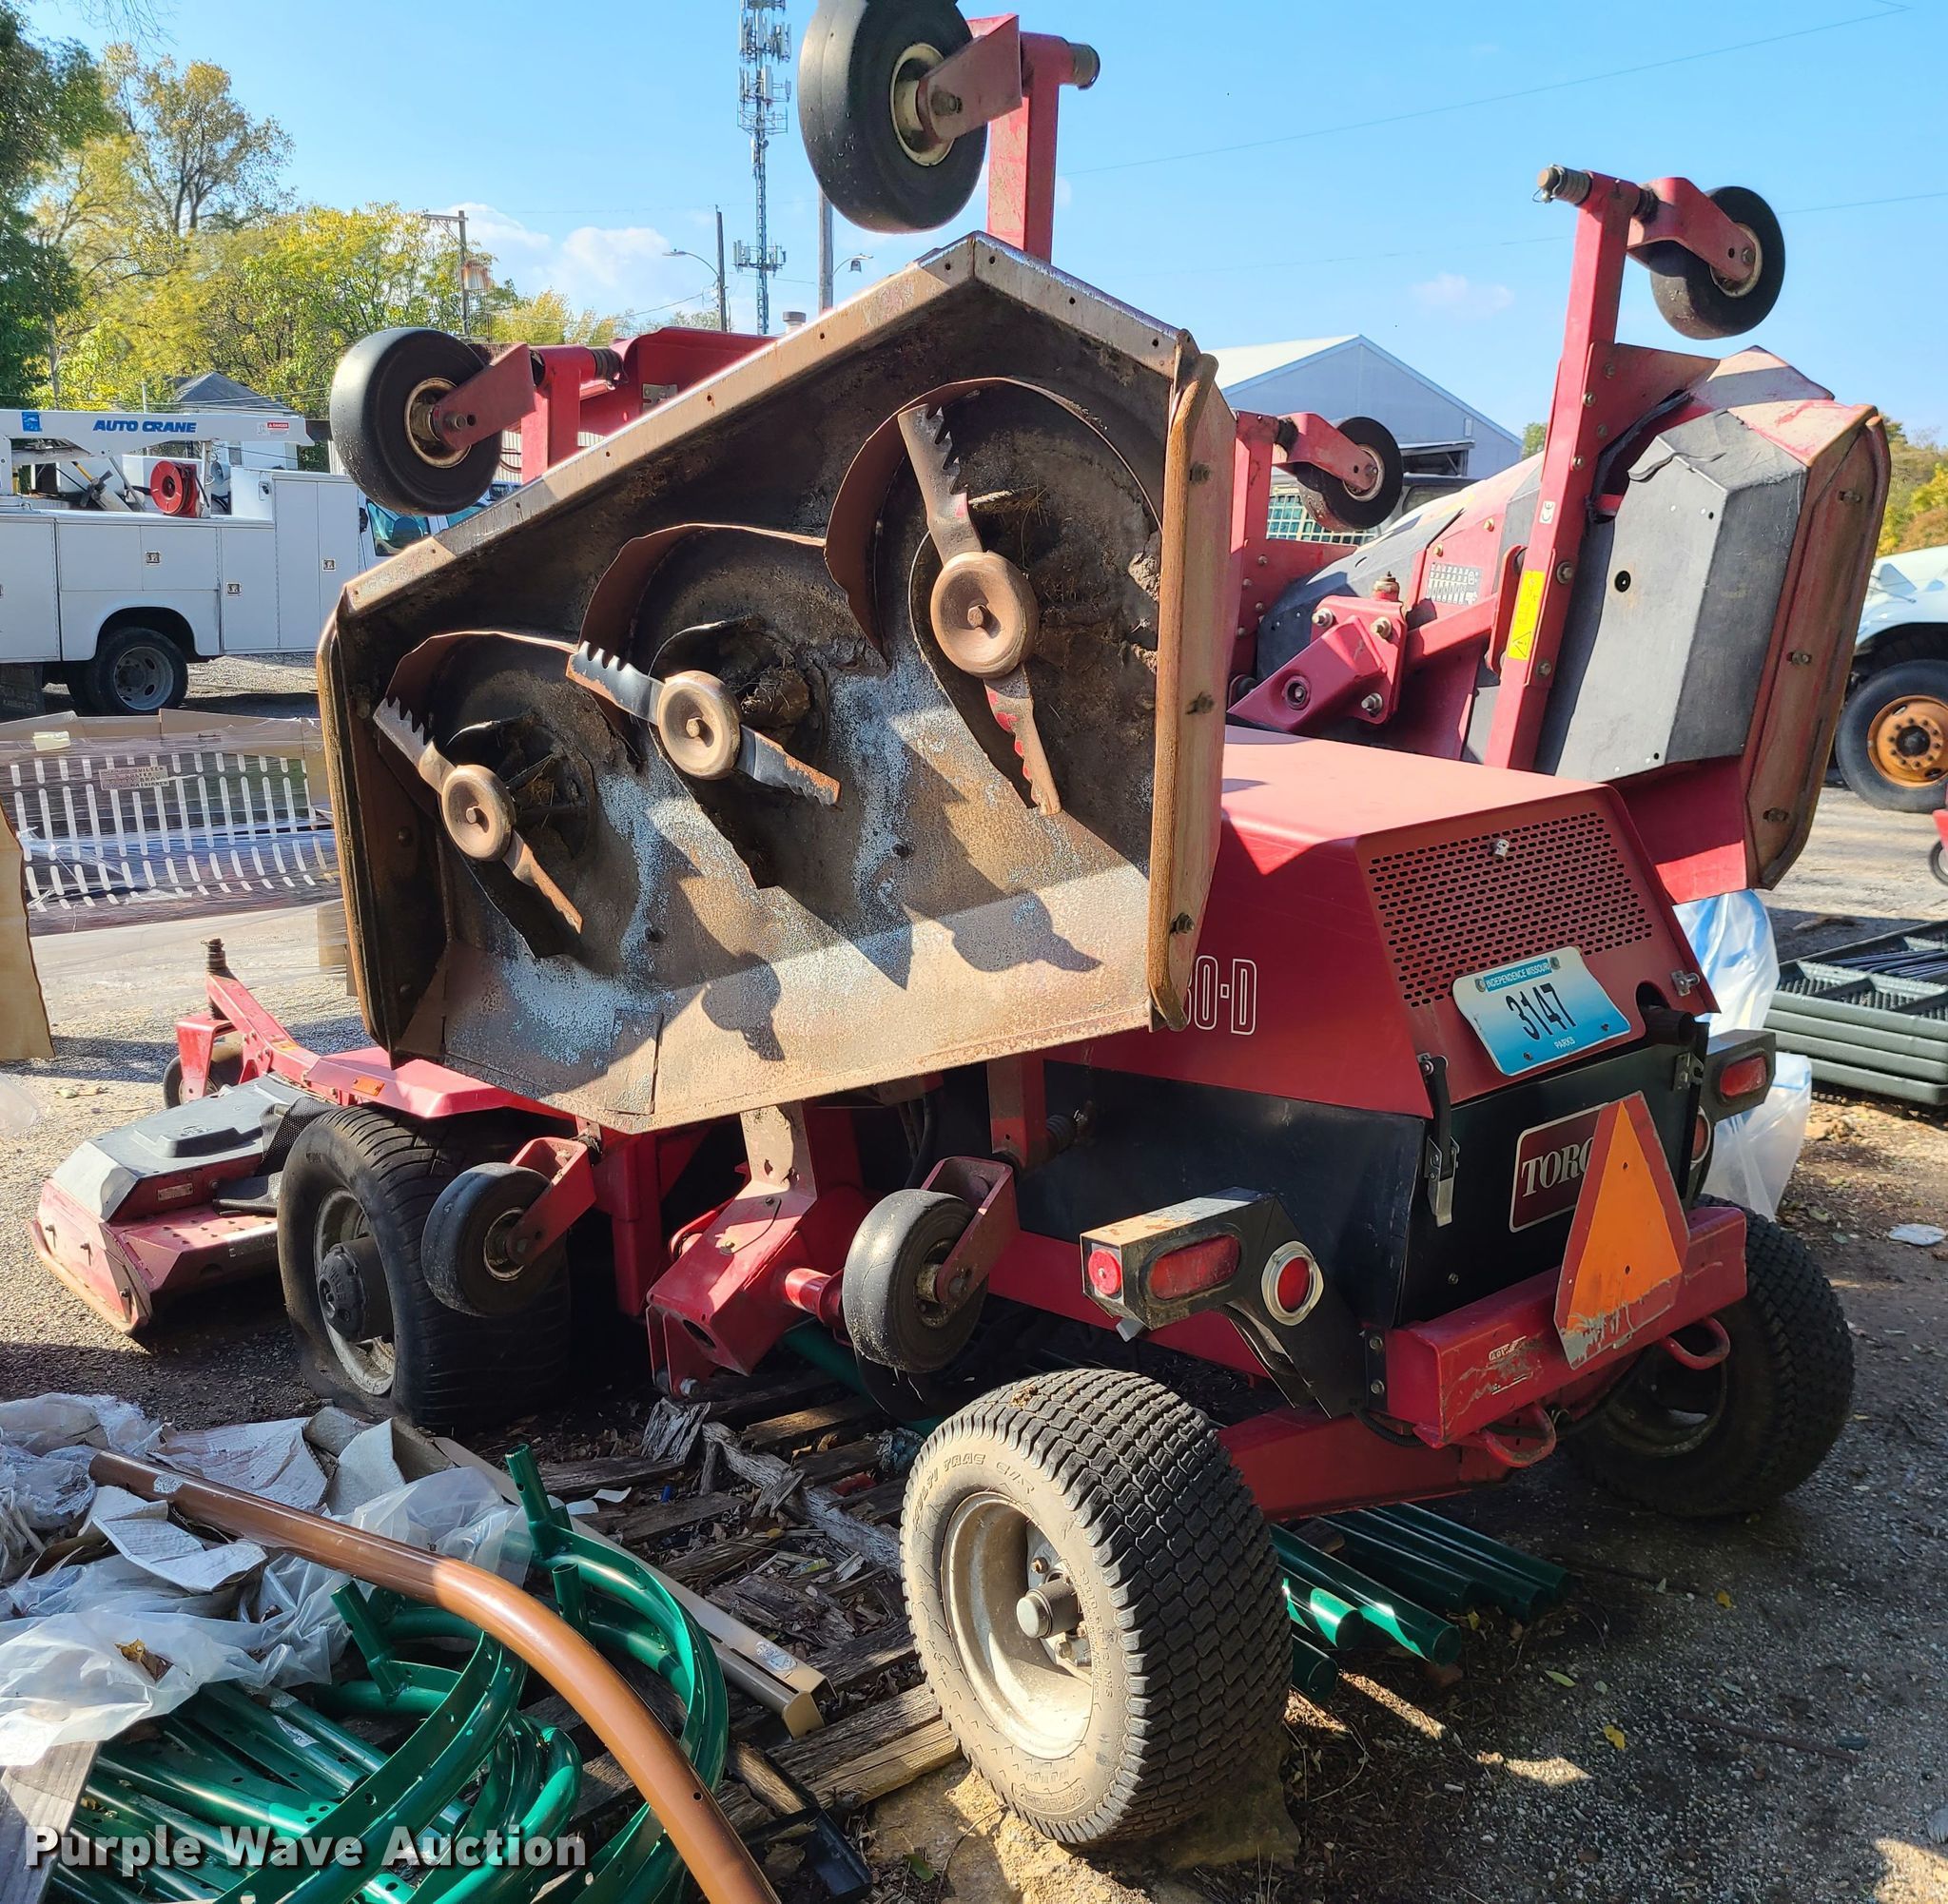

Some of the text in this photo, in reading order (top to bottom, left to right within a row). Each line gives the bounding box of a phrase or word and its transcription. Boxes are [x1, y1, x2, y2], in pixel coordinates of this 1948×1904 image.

[93, 419, 197, 433] AUTO CRANE
[1486, 962, 1551, 988] INDEPENDENCE MISSOURI
[1187, 955, 1257, 1035] 0-D
[1506, 982, 1576, 1040] 3147
[1553, 1037, 1576, 1050] PARKS
